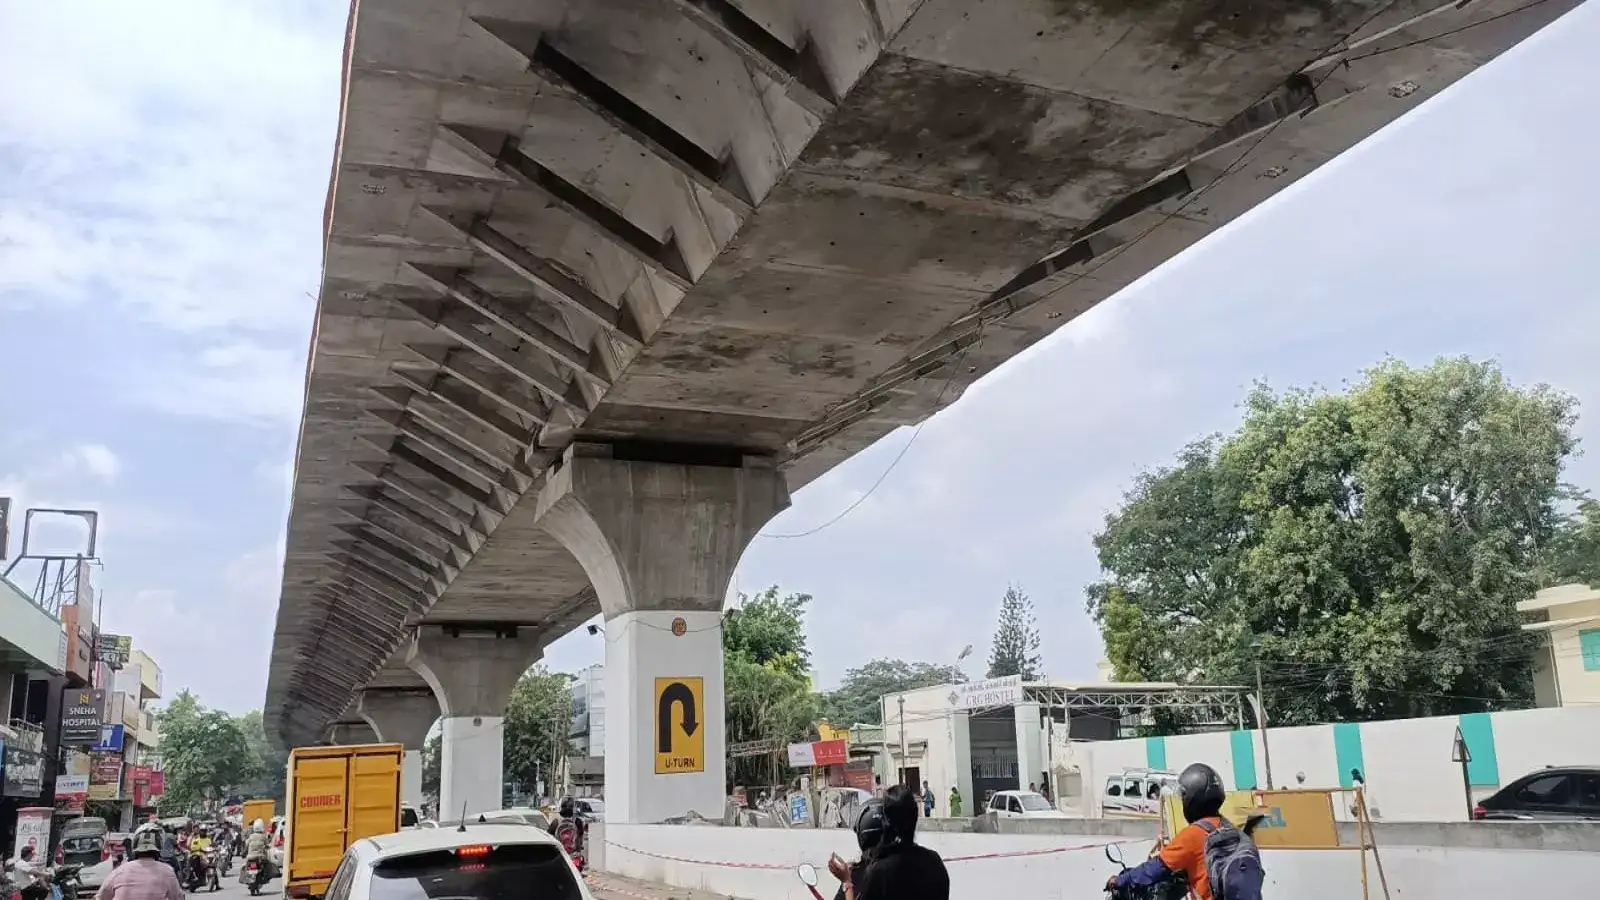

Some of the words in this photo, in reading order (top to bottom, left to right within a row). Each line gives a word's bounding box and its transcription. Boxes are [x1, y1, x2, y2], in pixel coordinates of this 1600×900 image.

[984, 689, 1015, 706] HOSTEL
[69, 707, 97, 715] SNEHA
[62, 718, 101, 726] HOSPITAL
[665, 757, 695, 768] U-TURN
[300, 794, 341, 808] COURIER
